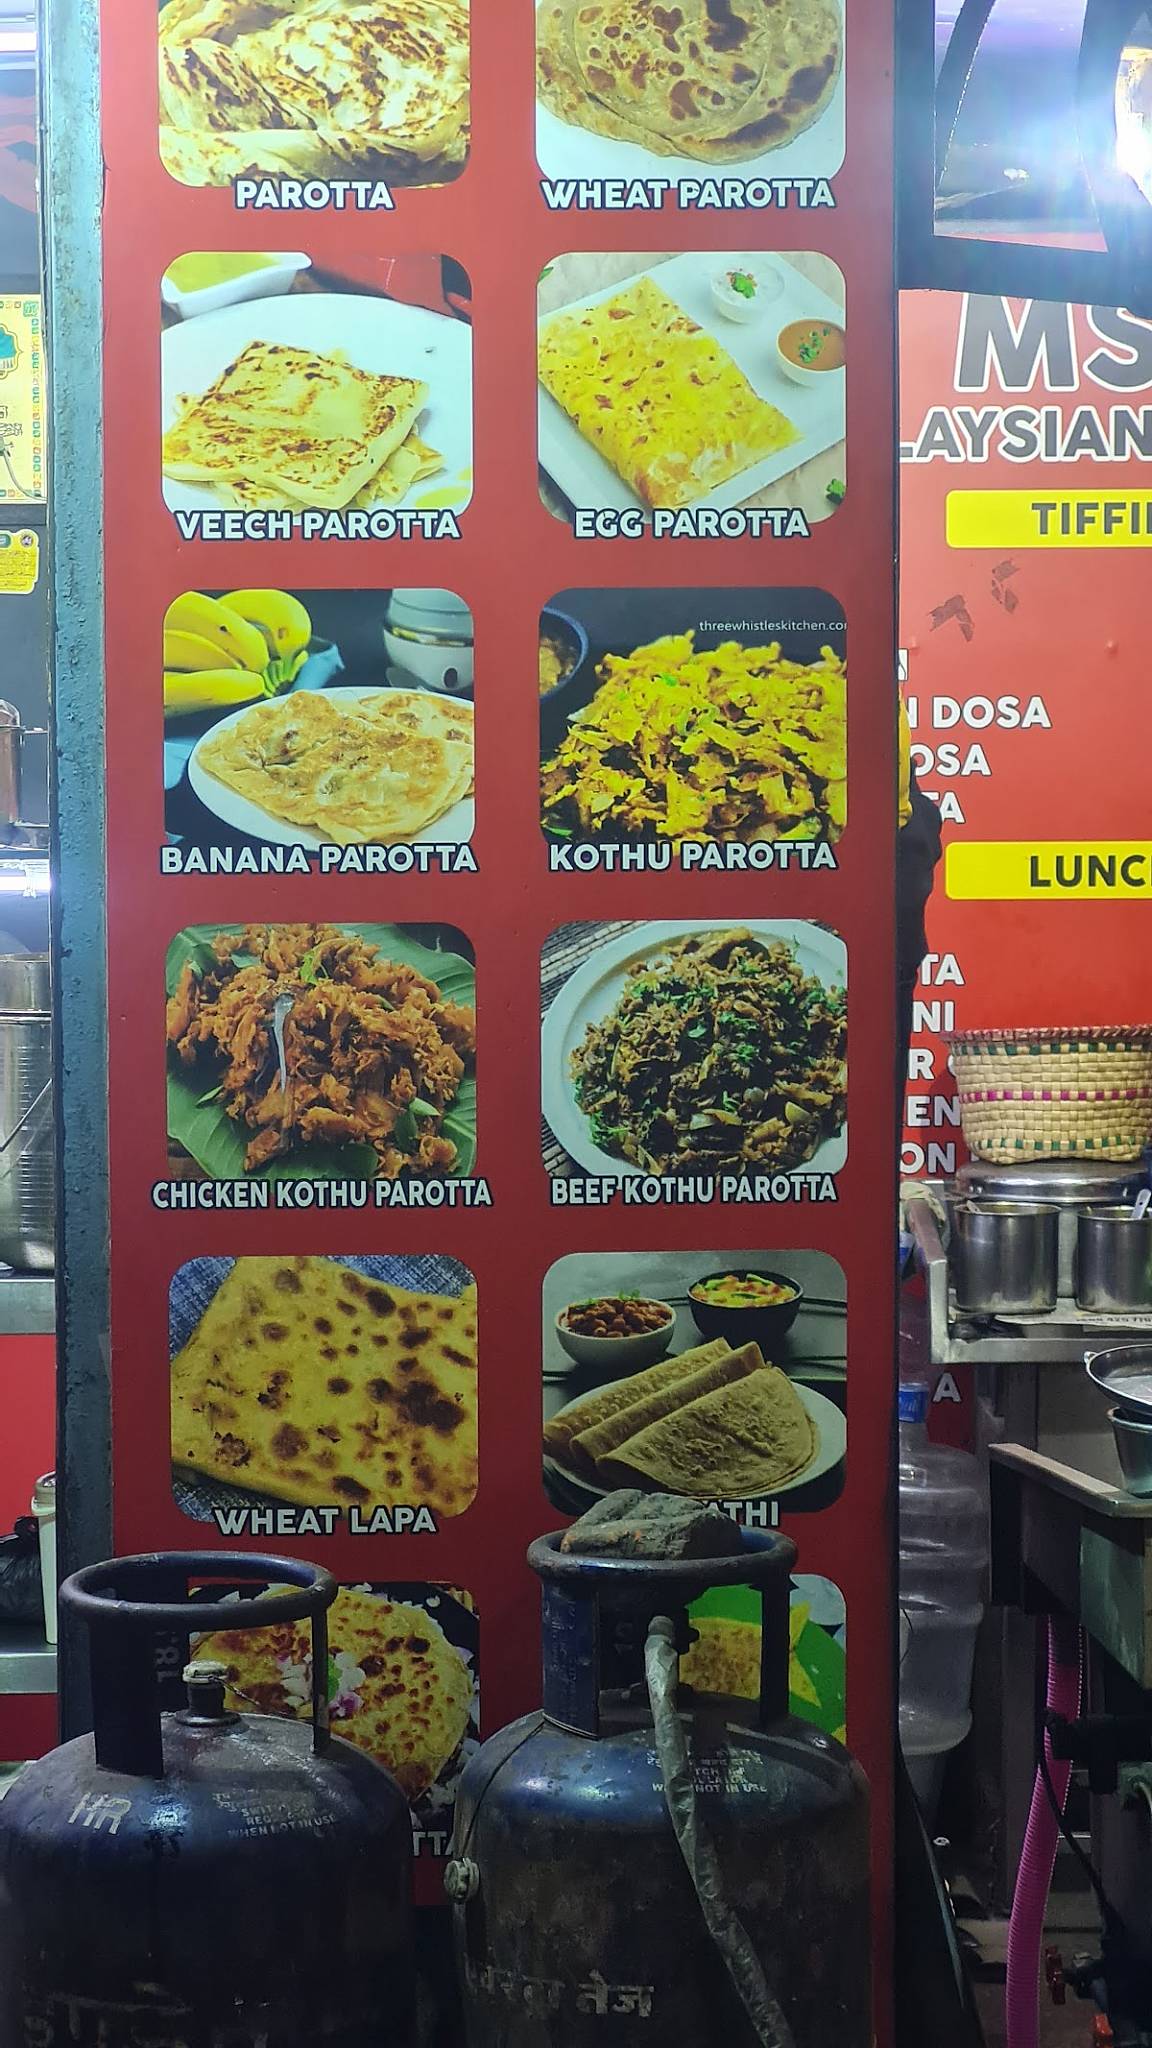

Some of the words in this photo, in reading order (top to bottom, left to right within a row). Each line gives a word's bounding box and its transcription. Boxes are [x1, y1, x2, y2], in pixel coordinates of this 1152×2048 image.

[236, 180, 394, 209] PAROTTA
[541, 180, 669, 209] WHEAT
[679, 180, 836, 209] PAROTTA
[900, 406, 1152, 463] AYSIAN
[175, 511, 292, 540] VEECH
[303, 511, 461, 539] PAROTTA
[575, 510, 643, 538] EGG
[654, 510, 810, 538] PAROTTA
[932, 695, 1052, 729] DOSA
[162, 846, 310, 873] BANANA
[321, 845, 478, 873] PAROTTA
[550, 843, 670, 870] KOTHU
[682, 842, 837, 870] PAROTTA
[1030, 854, 1152, 888] LUNC
[152, 1181, 269, 1208] CHICKEN
[276, 1181, 367, 1207] KOTHU
[375, 1180, 493, 1206] PAROTTA
[551, 1177, 617, 1204] BEEF
[624, 1176, 714, 1204] KOTHU
[722, 1175, 837, 1202] PAROTTA
[214, 1508, 340, 1534] WHEAT
[351, 1507, 437, 1533] LAPA
